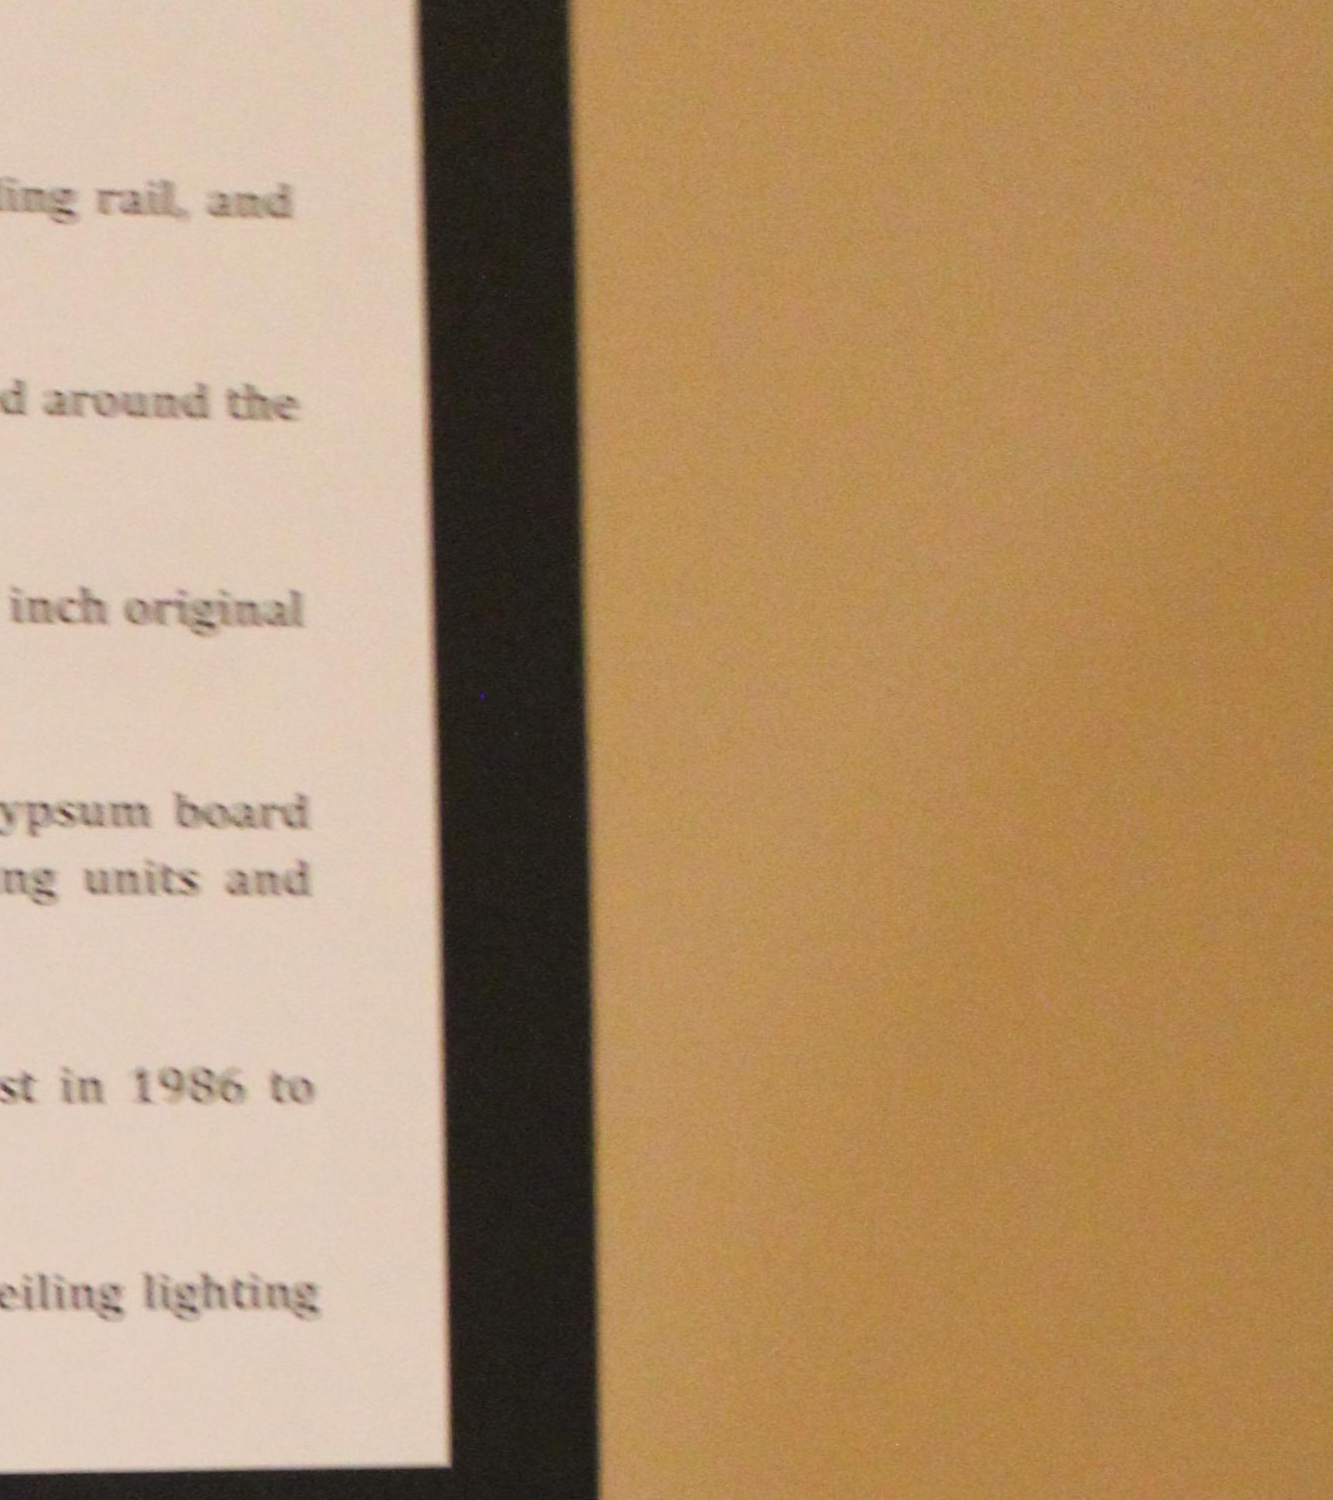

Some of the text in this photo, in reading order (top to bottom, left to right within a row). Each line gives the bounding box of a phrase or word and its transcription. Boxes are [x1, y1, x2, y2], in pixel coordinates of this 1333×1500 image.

[96, 179, 189, 218] rail,
[206, 182, 294, 221] and
[42, 381, 211, 421] around
[224, 381, 300, 423] the
[9, 584, 109, 626] inch
[122, 588, 304, 637] original
[174, 791, 310, 830] board
[82, 855, 202, 897] units
[225, 859, 312, 898] and
[60, 1065, 107, 1106] in
[134, 1065, 247, 1104] 1986
[268, 1070, 316, 1104] to
[143, 1271, 321, 1321] lighting
